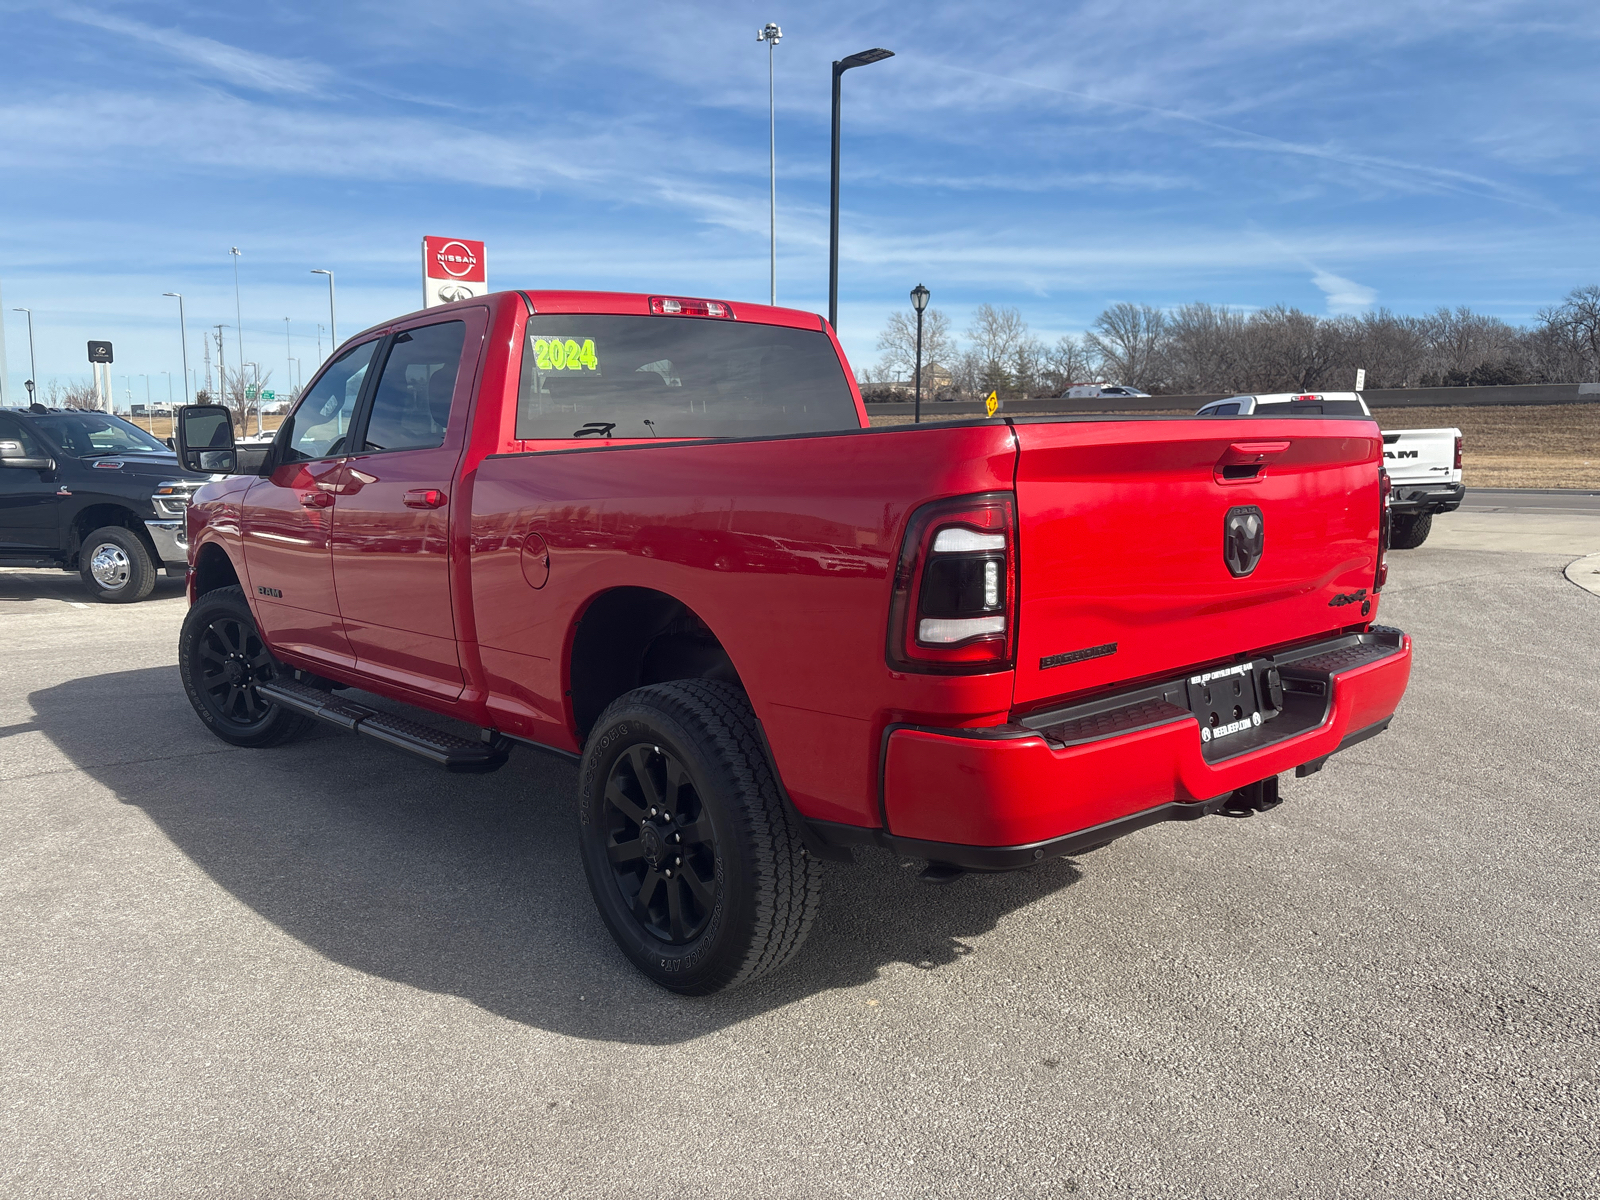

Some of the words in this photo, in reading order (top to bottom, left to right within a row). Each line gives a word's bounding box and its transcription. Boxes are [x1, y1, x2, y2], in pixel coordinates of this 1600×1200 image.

[437, 253, 476, 264] NISSAN
[535, 339, 598, 370] 2024
[1383, 450, 1418, 459] AM
[257, 586, 283, 598] RAM
